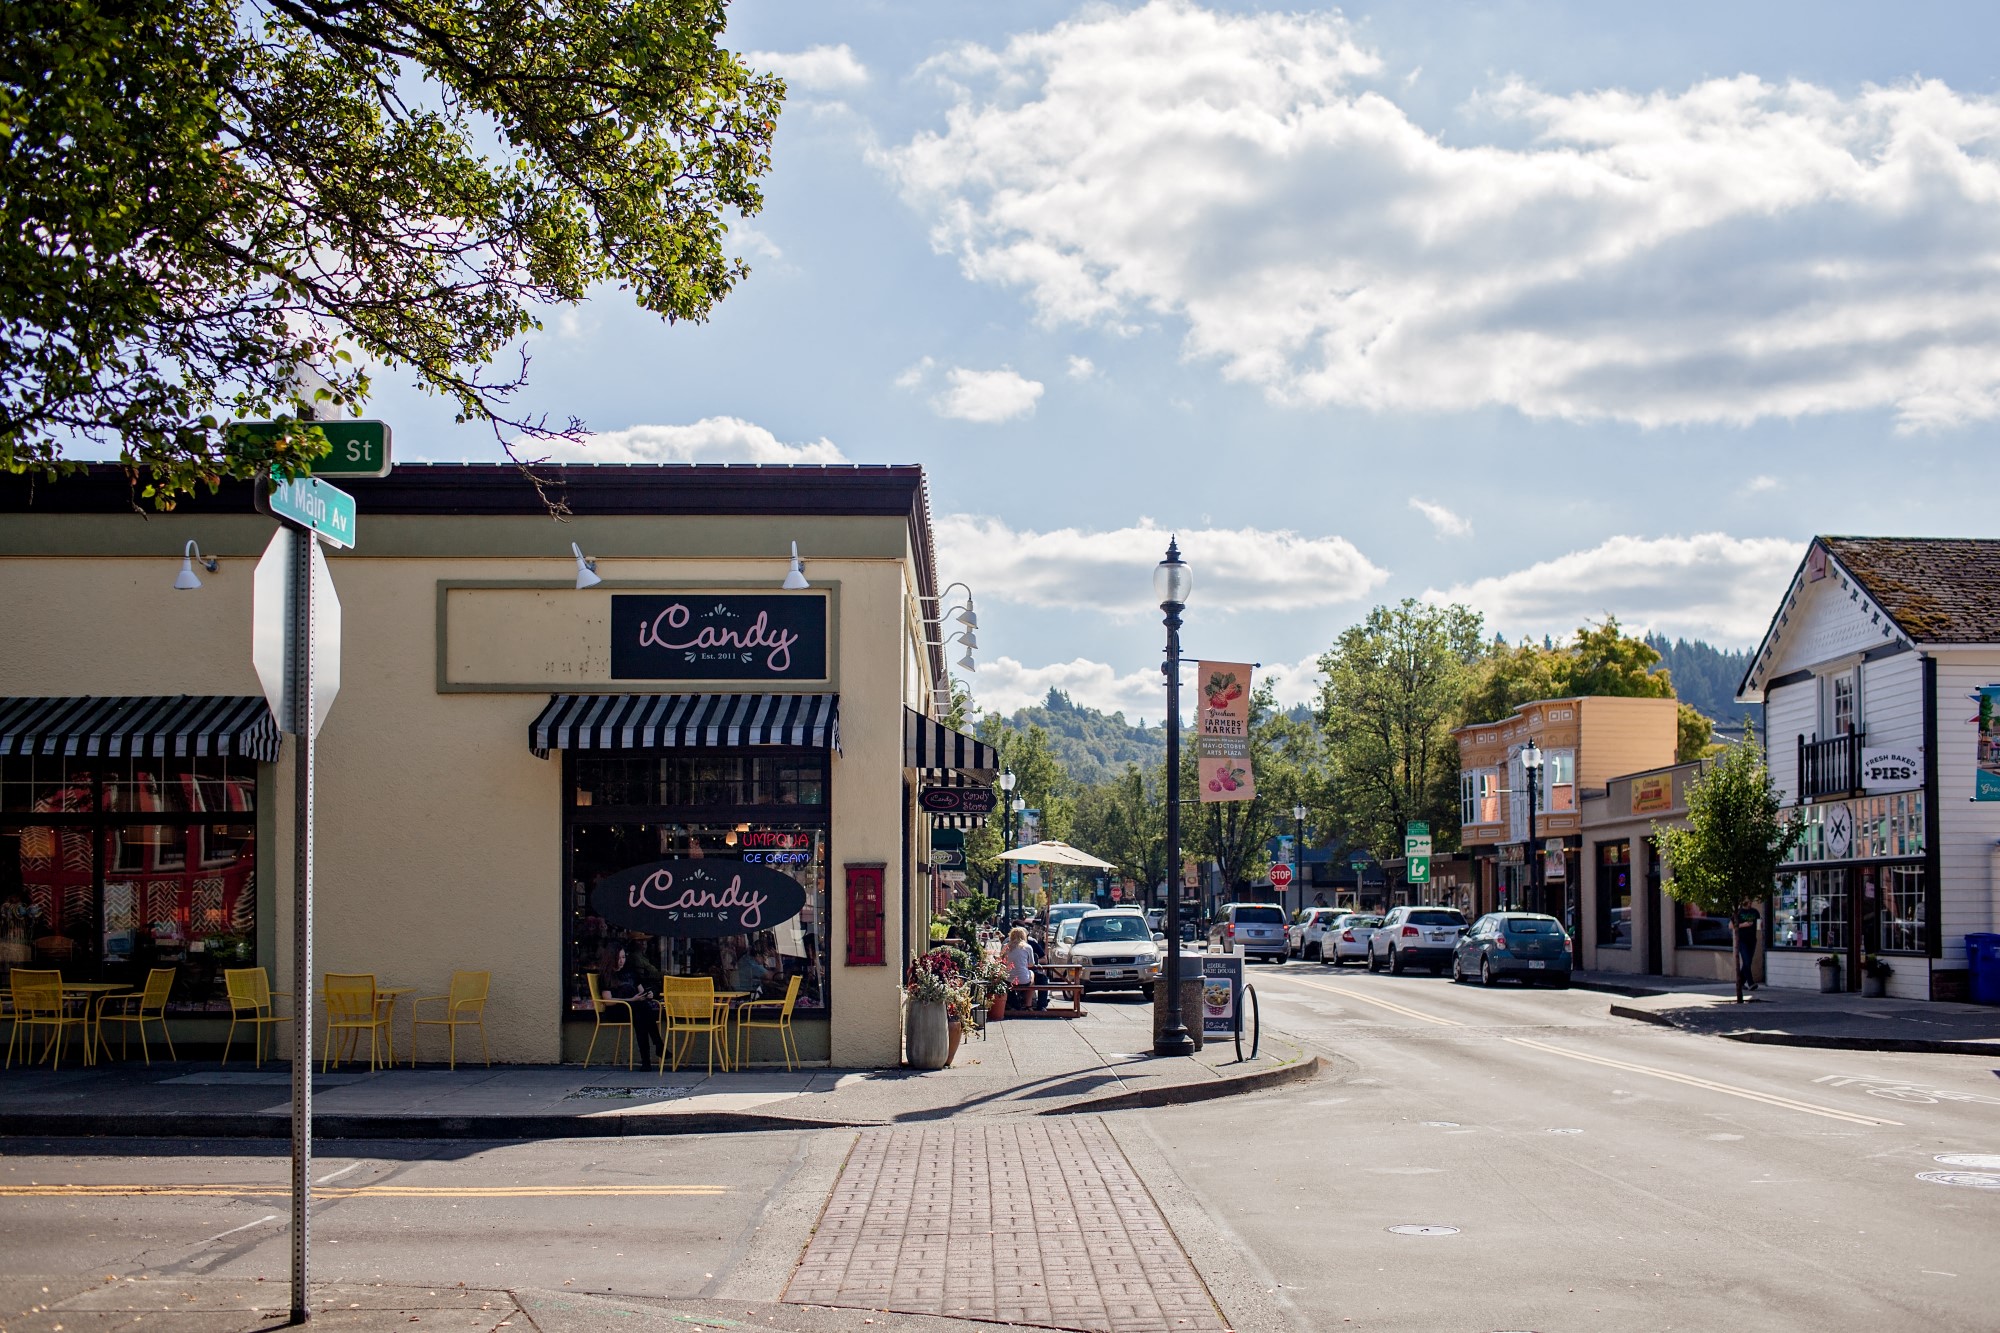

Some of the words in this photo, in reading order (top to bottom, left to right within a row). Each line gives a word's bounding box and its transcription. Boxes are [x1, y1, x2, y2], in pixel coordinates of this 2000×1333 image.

[346, 439, 372, 461] St
[280, 480, 288, 503] N
[295, 478, 326, 522] Main
[332, 507, 347, 532] Av
[639, 603, 798, 672] iCandy
[717, 652, 736, 660] 2011
[1205, 726, 1241, 734] MARKET
[1865, 754, 1889, 767] FRESH
[1891, 754, 1916, 767] BAKED
[1871, 767, 1911, 780] PIES
[963, 790, 990, 802] Candy
[963, 802, 988, 811] Store
[743, 833, 809, 847] UMPQUA
[743, 853, 761, 864] ICE
[766, 853, 809, 863] CREAM
[1271, 870, 1290, 880] STOP
[629, 869, 768, 928] iCandy
